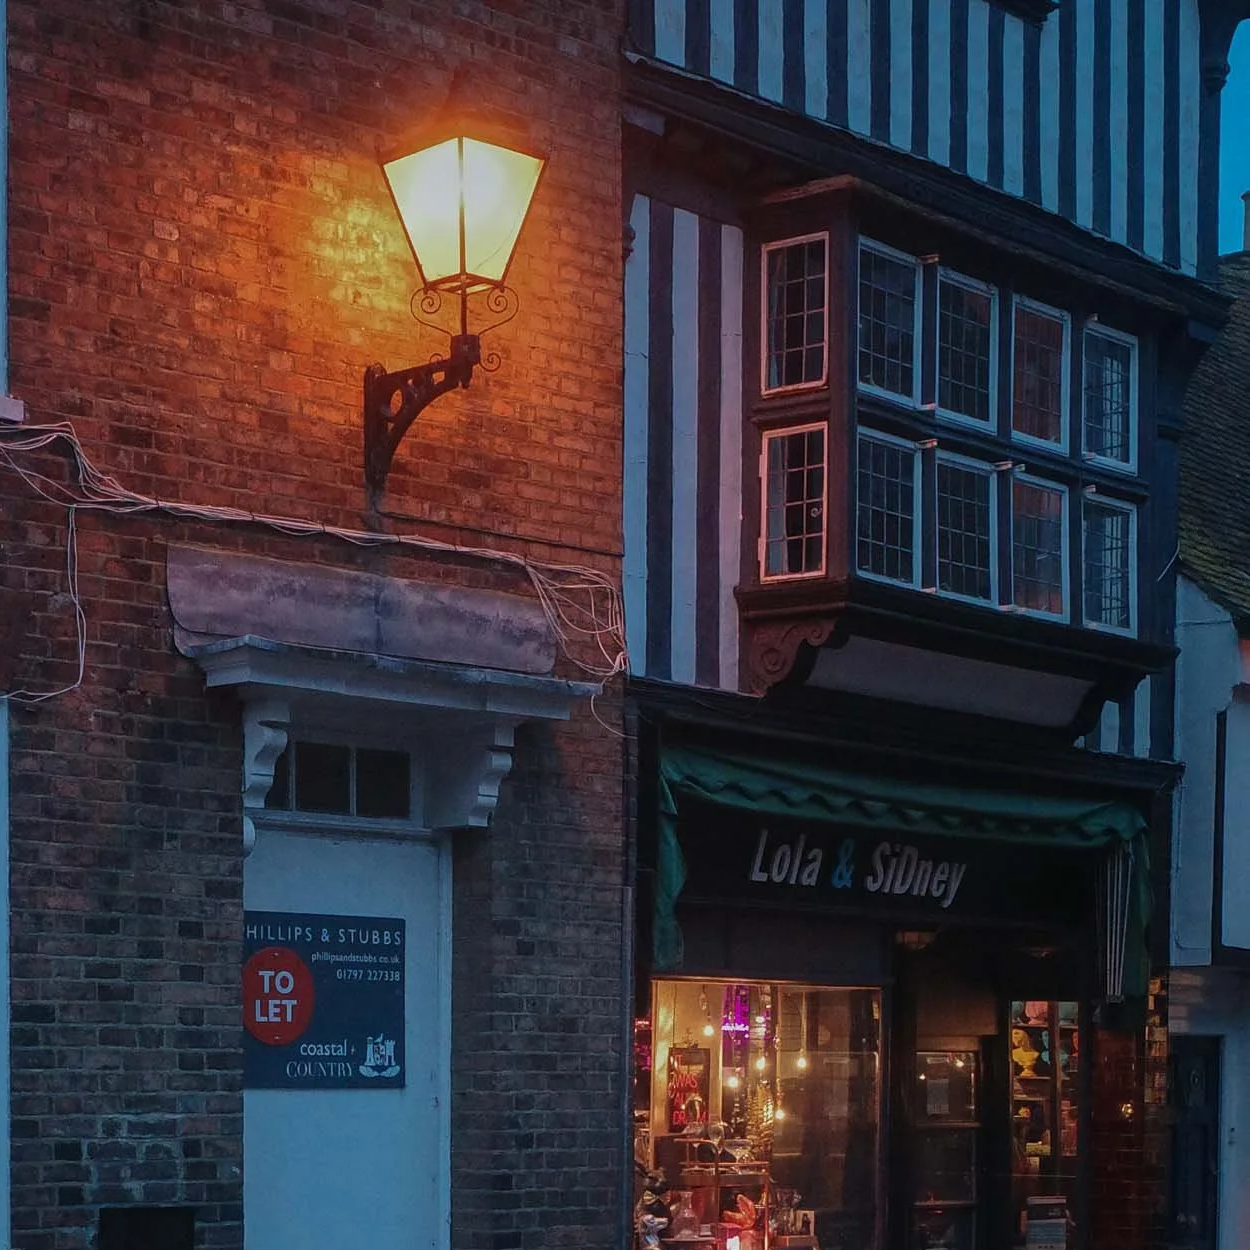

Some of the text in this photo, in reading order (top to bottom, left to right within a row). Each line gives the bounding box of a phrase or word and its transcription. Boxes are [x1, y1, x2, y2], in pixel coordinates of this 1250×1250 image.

[750, 828, 823, 887] Lola
[831, 838, 855, 889] &
[246, 924, 401, 945] HILLIPS & STUBBS
[258, 970, 294, 994] TO
[336, 968, 363, 981] 01797
[254, 999, 298, 1023] LET
[300, 1039, 348, 1056] coastal
[286, 1060, 353, 1078] COUNTRY
